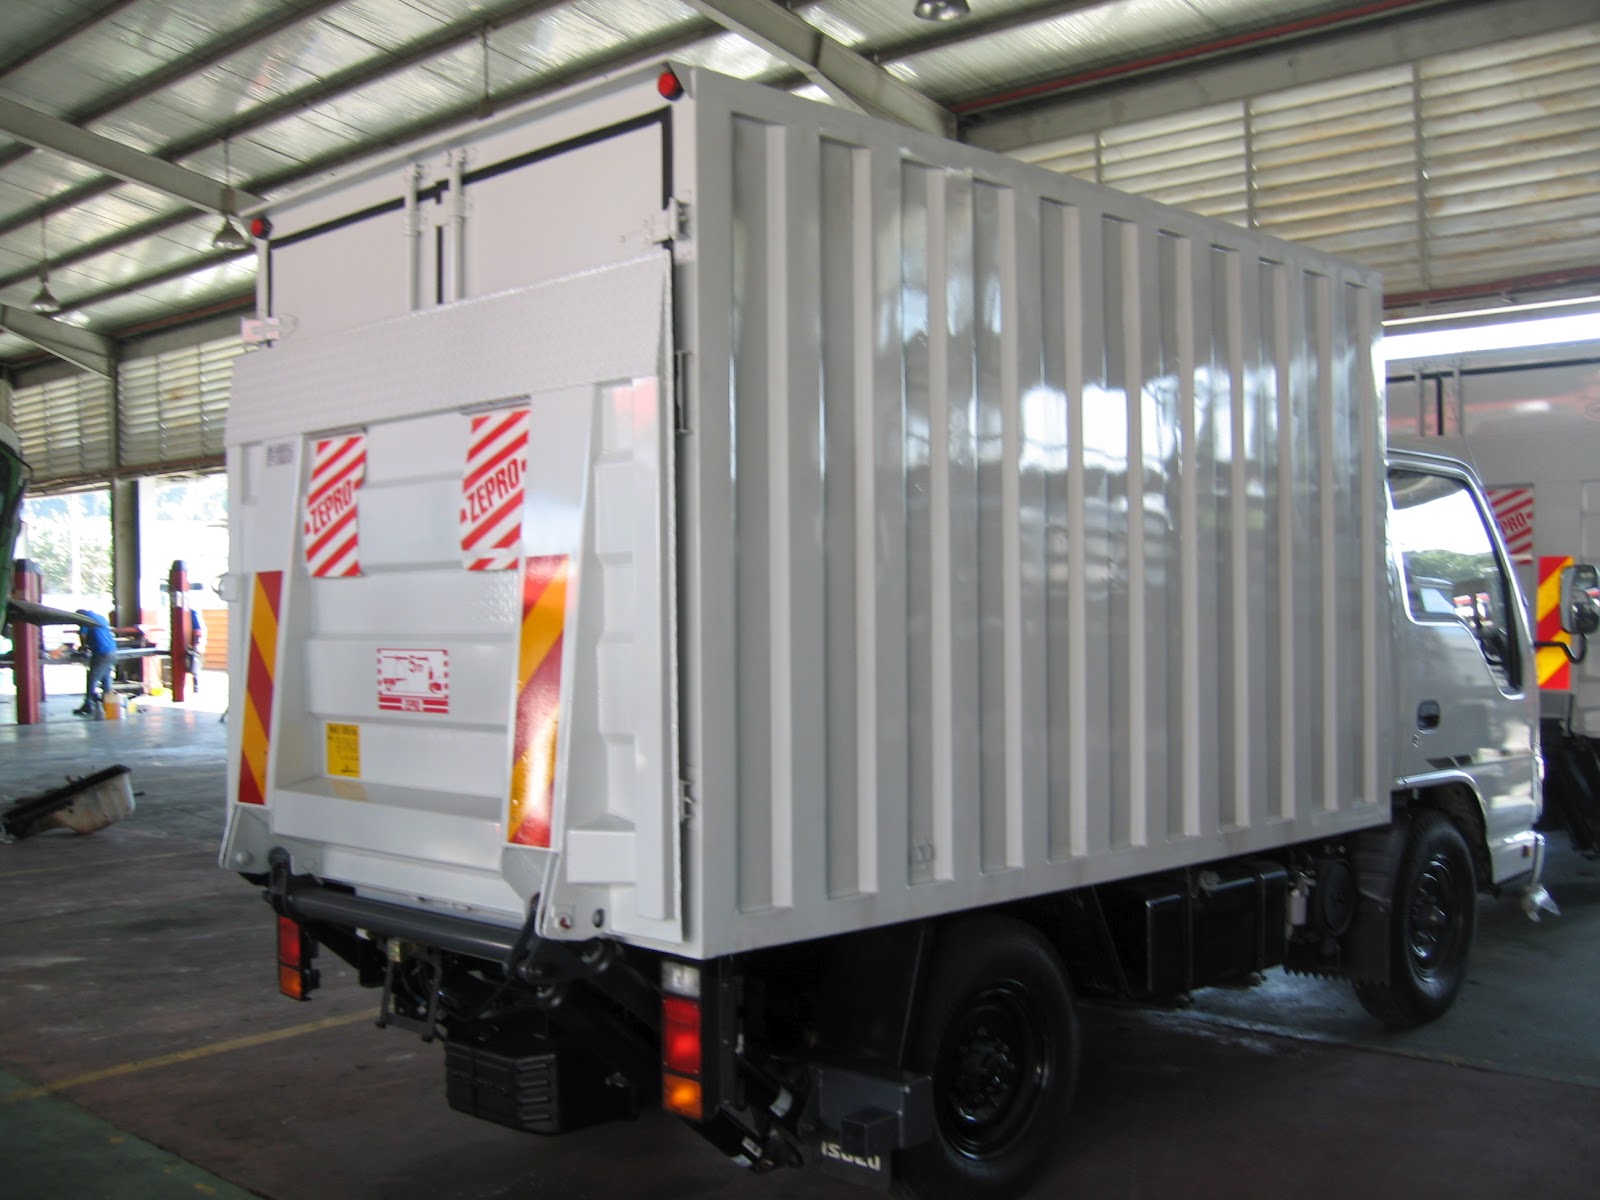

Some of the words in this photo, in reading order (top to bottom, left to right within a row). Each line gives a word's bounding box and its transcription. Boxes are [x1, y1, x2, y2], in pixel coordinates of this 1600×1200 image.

[310, 480, 352, 534] ZEPRO
[466, 458, 519, 523] ZEPRO
[1500, 511, 1527, 535] PRO
